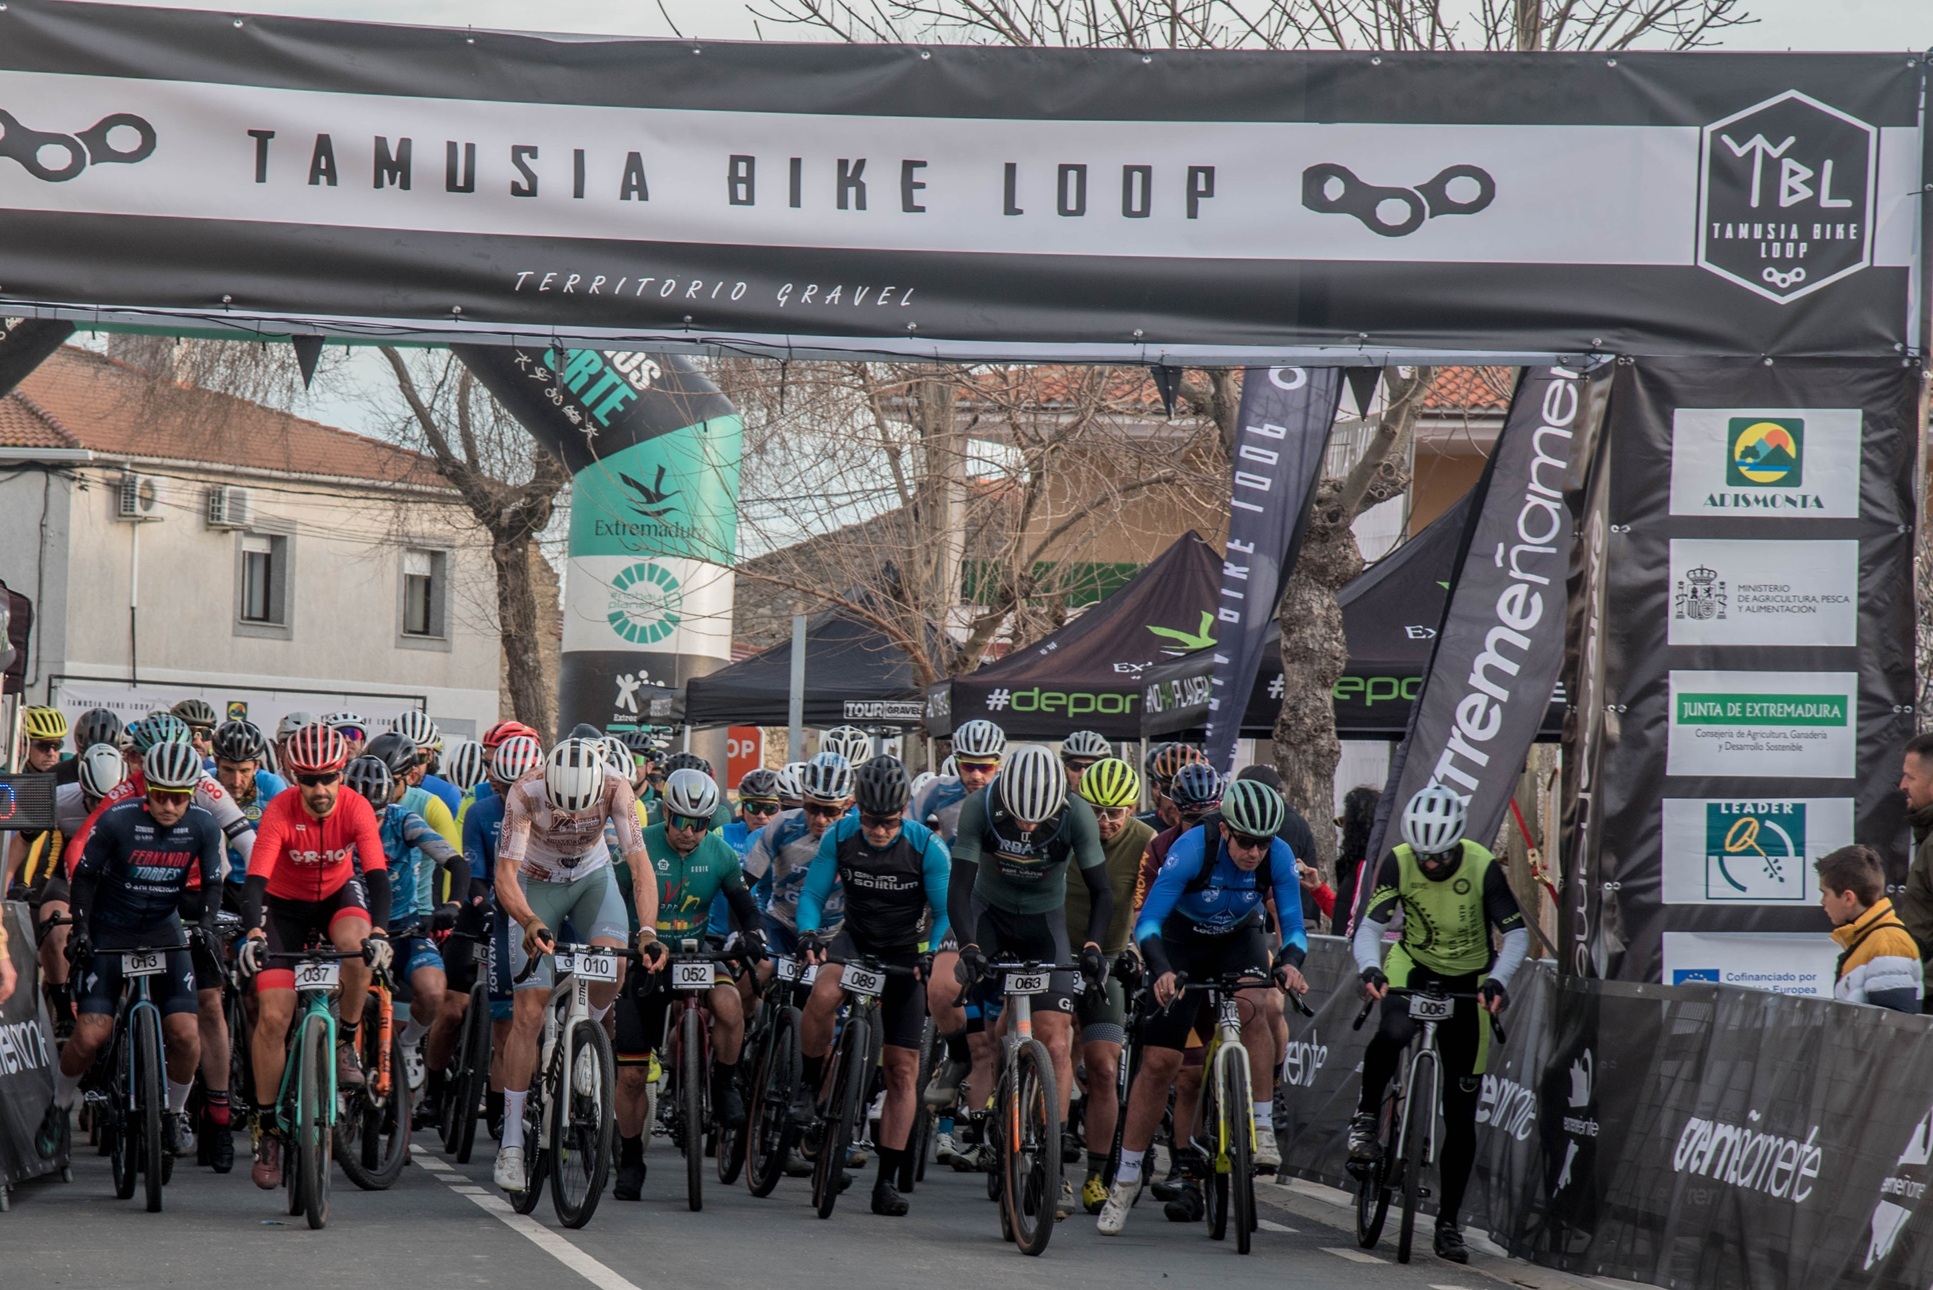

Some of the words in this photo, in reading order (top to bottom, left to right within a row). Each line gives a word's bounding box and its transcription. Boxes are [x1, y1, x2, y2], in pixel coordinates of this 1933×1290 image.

[247, 129, 649, 201] TAMUSIA
[727, 154, 928, 213] BIKE
[1003, 162, 1215, 219] LOOP
[1713, 223, 1799, 239] TAMUSIA
[1813, 224, 1857, 239] BIKE
[1761, 242, 1808, 258] LOOP
[514, 270, 747, 300] TERRITORIO
[777, 283, 915, 307] GRAVEL
[1704, 493, 1824, 509] ADISMONTA
[1737, 584, 1791, 592] MINISTERIO
[1737, 594, 1750, 602] DE
[1821, 595, 1850, 603] PESCA
[1737, 605, 1744, 613] Y
[846, 702, 883, 718] TOUR
[1683, 702, 1723, 718] JUNTA
[1727, 703, 1742, 717] DE
[1745, 703, 1841, 718] EXTREMADURA
[1736, 730, 1746, 738] de
[1718, 744, 1723, 752] y
[1765, 742, 1803, 751] Sostenible
[1720, 801, 1793, 814] LEADER
[128, 849, 191, 867] FERNANDO
[854, 871, 897, 882] GRUPO
[854, 878, 918, 890] solitium
[131, 955, 157, 969] 013
[583, 957, 609, 974] 010
[304, 967, 329, 982] 037
[682, 967, 706, 981] 052
[851, 971, 876, 989] 089
[1726, 972, 1796, 981] Cofinanciado
[1799, 973, 1817, 983] por
[1015, 977, 1041, 989] 063
[1773, 985, 1817, 995] Europea
[1419, 1001, 1446, 1015] 006
